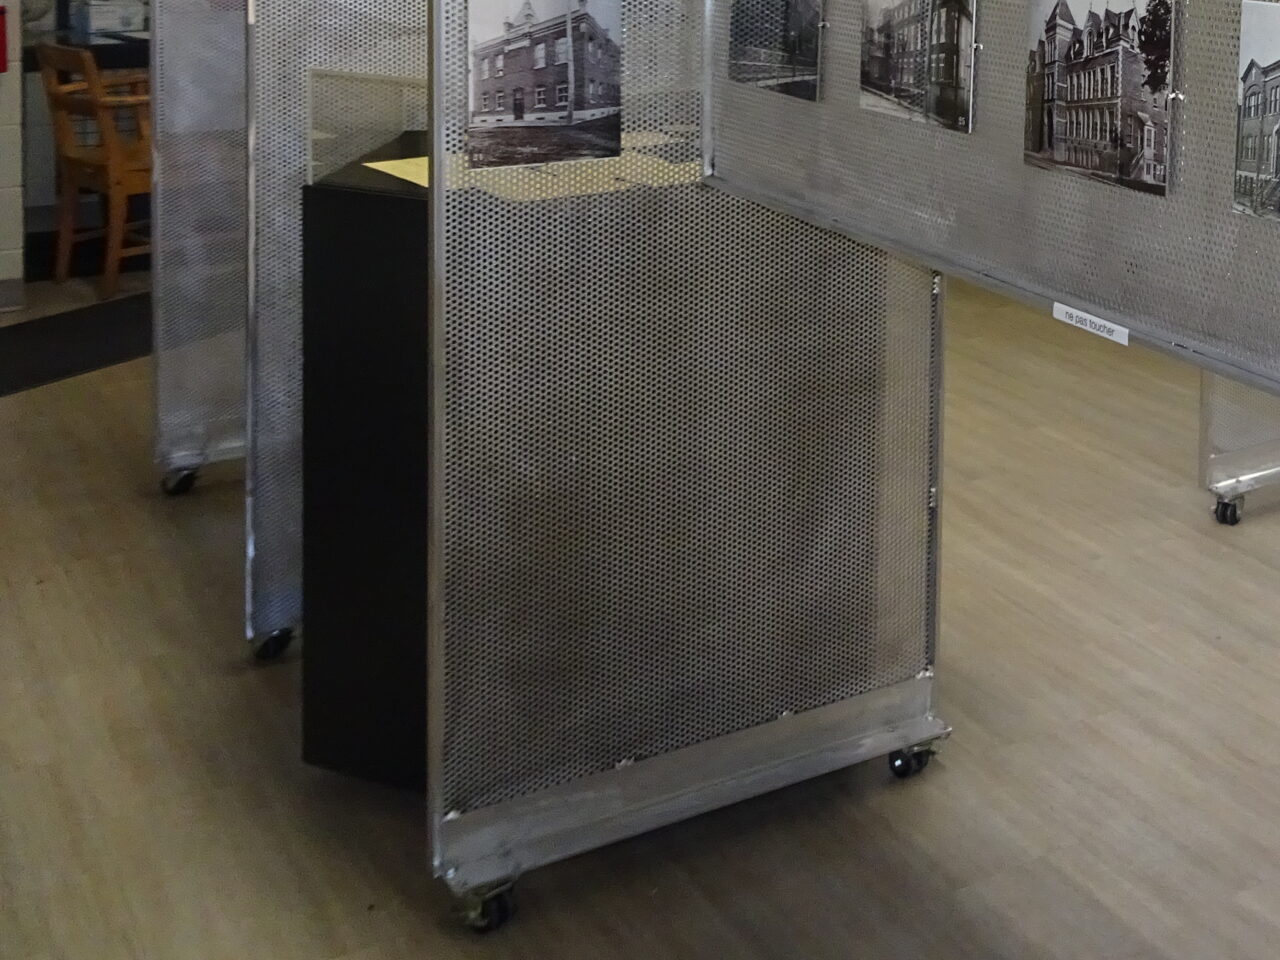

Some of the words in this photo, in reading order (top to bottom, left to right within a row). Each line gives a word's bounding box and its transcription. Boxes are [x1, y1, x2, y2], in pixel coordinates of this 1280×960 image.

[1065, 311, 1074, 322] ne
[1075, 315, 1088, 327] pas
[1089, 319, 1116, 337] toucher
